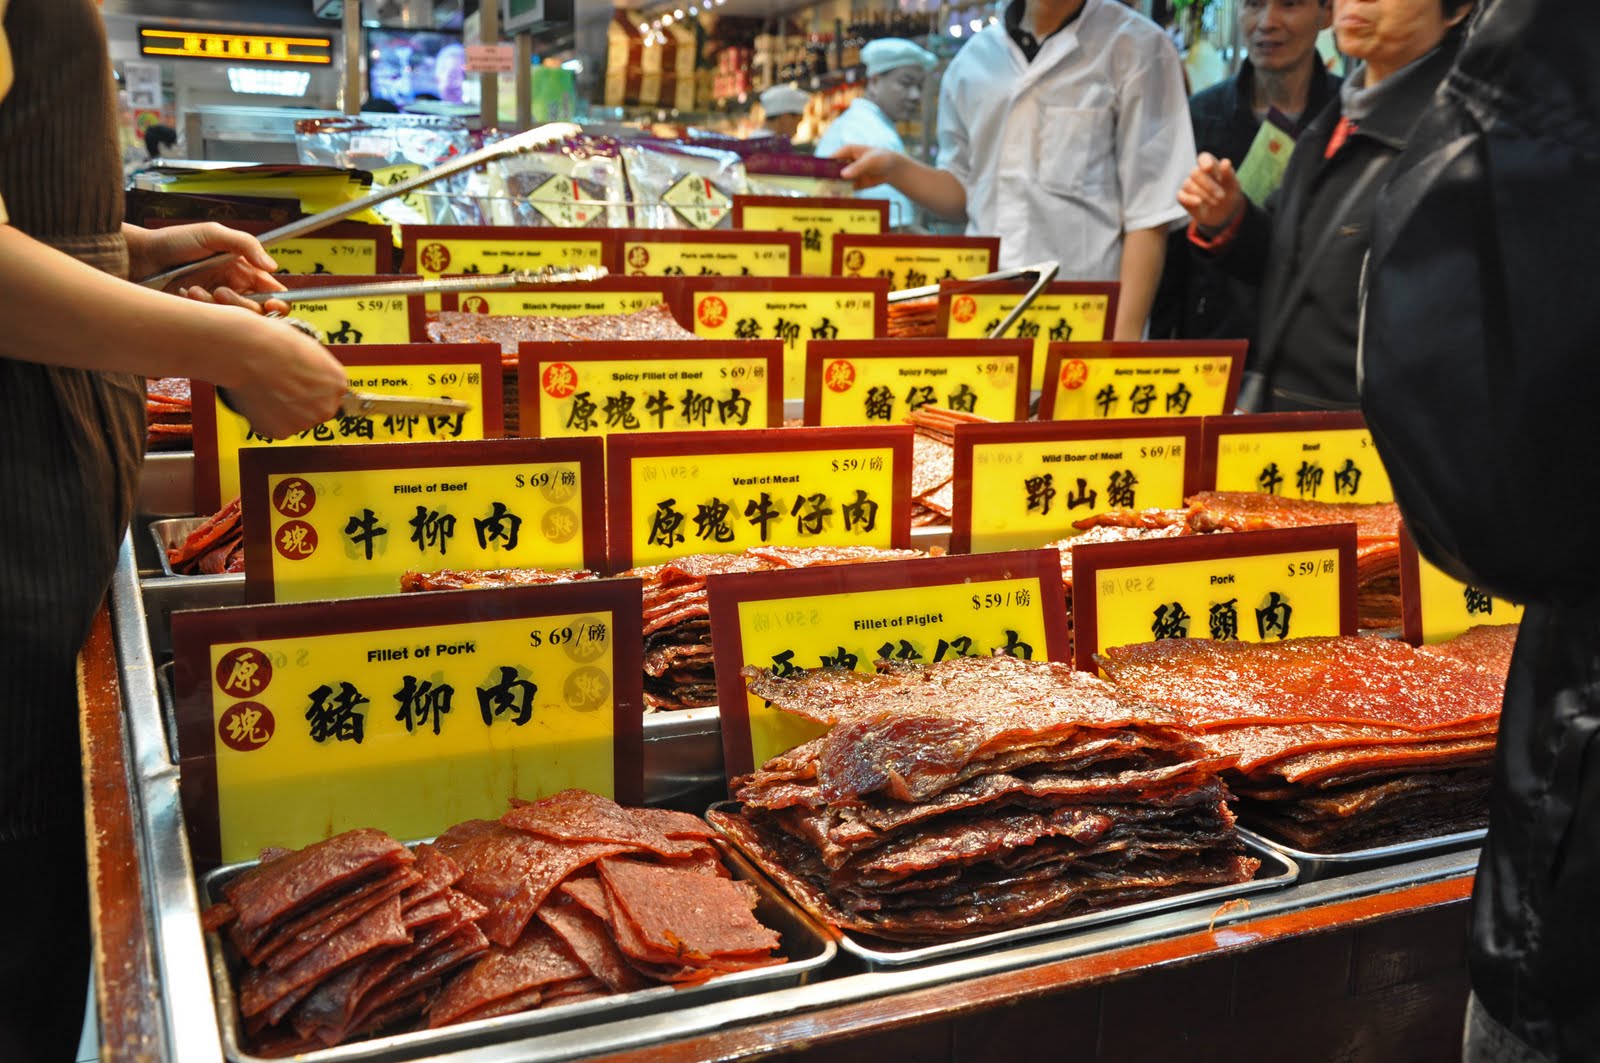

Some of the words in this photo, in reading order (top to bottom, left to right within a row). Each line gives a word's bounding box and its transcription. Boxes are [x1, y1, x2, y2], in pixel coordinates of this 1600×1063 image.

[300, 304, 327, 312] Piglet
[551, 303, 582, 311] Pepper
[612, 373, 639, 382] Spicy
[642, 372, 667, 381] Fillet
[669, 371, 678, 380] of
[681, 371, 703, 380] Beef
[899, 368, 922, 377] Spicy
[924, 367, 947, 377] Piglet
[367, 379, 377, 387] of
[382, 378, 408, 387] Pork
[864, 384, 977, 421] 豬仔肉
[1096, 382, 1192, 417] 牛仔肉
[566, 388, 752, 432] 原塊牛柳肉
[1302, 443, 1320, 452] Beef
[1042, 455, 1061, 463] Wild
[1064, 454, 1086, 463] Boar
[1089, 453, 1098, 461] of
[1101, 452, 1123, 461] Meat
[733, 476, 757, 487] Veal
[759, 475, 771, 486] of
[773, 474, 800, 485] Meat
[1259, 459, 1362, 498] 牛柳肉
[394, 484, 422, 494] Fillet
[425, 483, 437, 493] of
[441, 482, 468, 493] Beef
[1024, 469, 1139, 515] 野山豬
[648, 489, 878, 548] 原塊牛仔肉
[345, 502, 522, 560] 牛柳肉
[1210, 574, 1235, 585] Pork
[853, 617, 888, 631] Fillet
[891, 616, 904, 628] of
[906, 613, 944, 628] Piglet
[367, 646, 409, 663] Fillet
[414, 645, 430, 659] of
[436, 642, 476, 656] Pork
[305, 666, 538, 744] 豬柳肉
